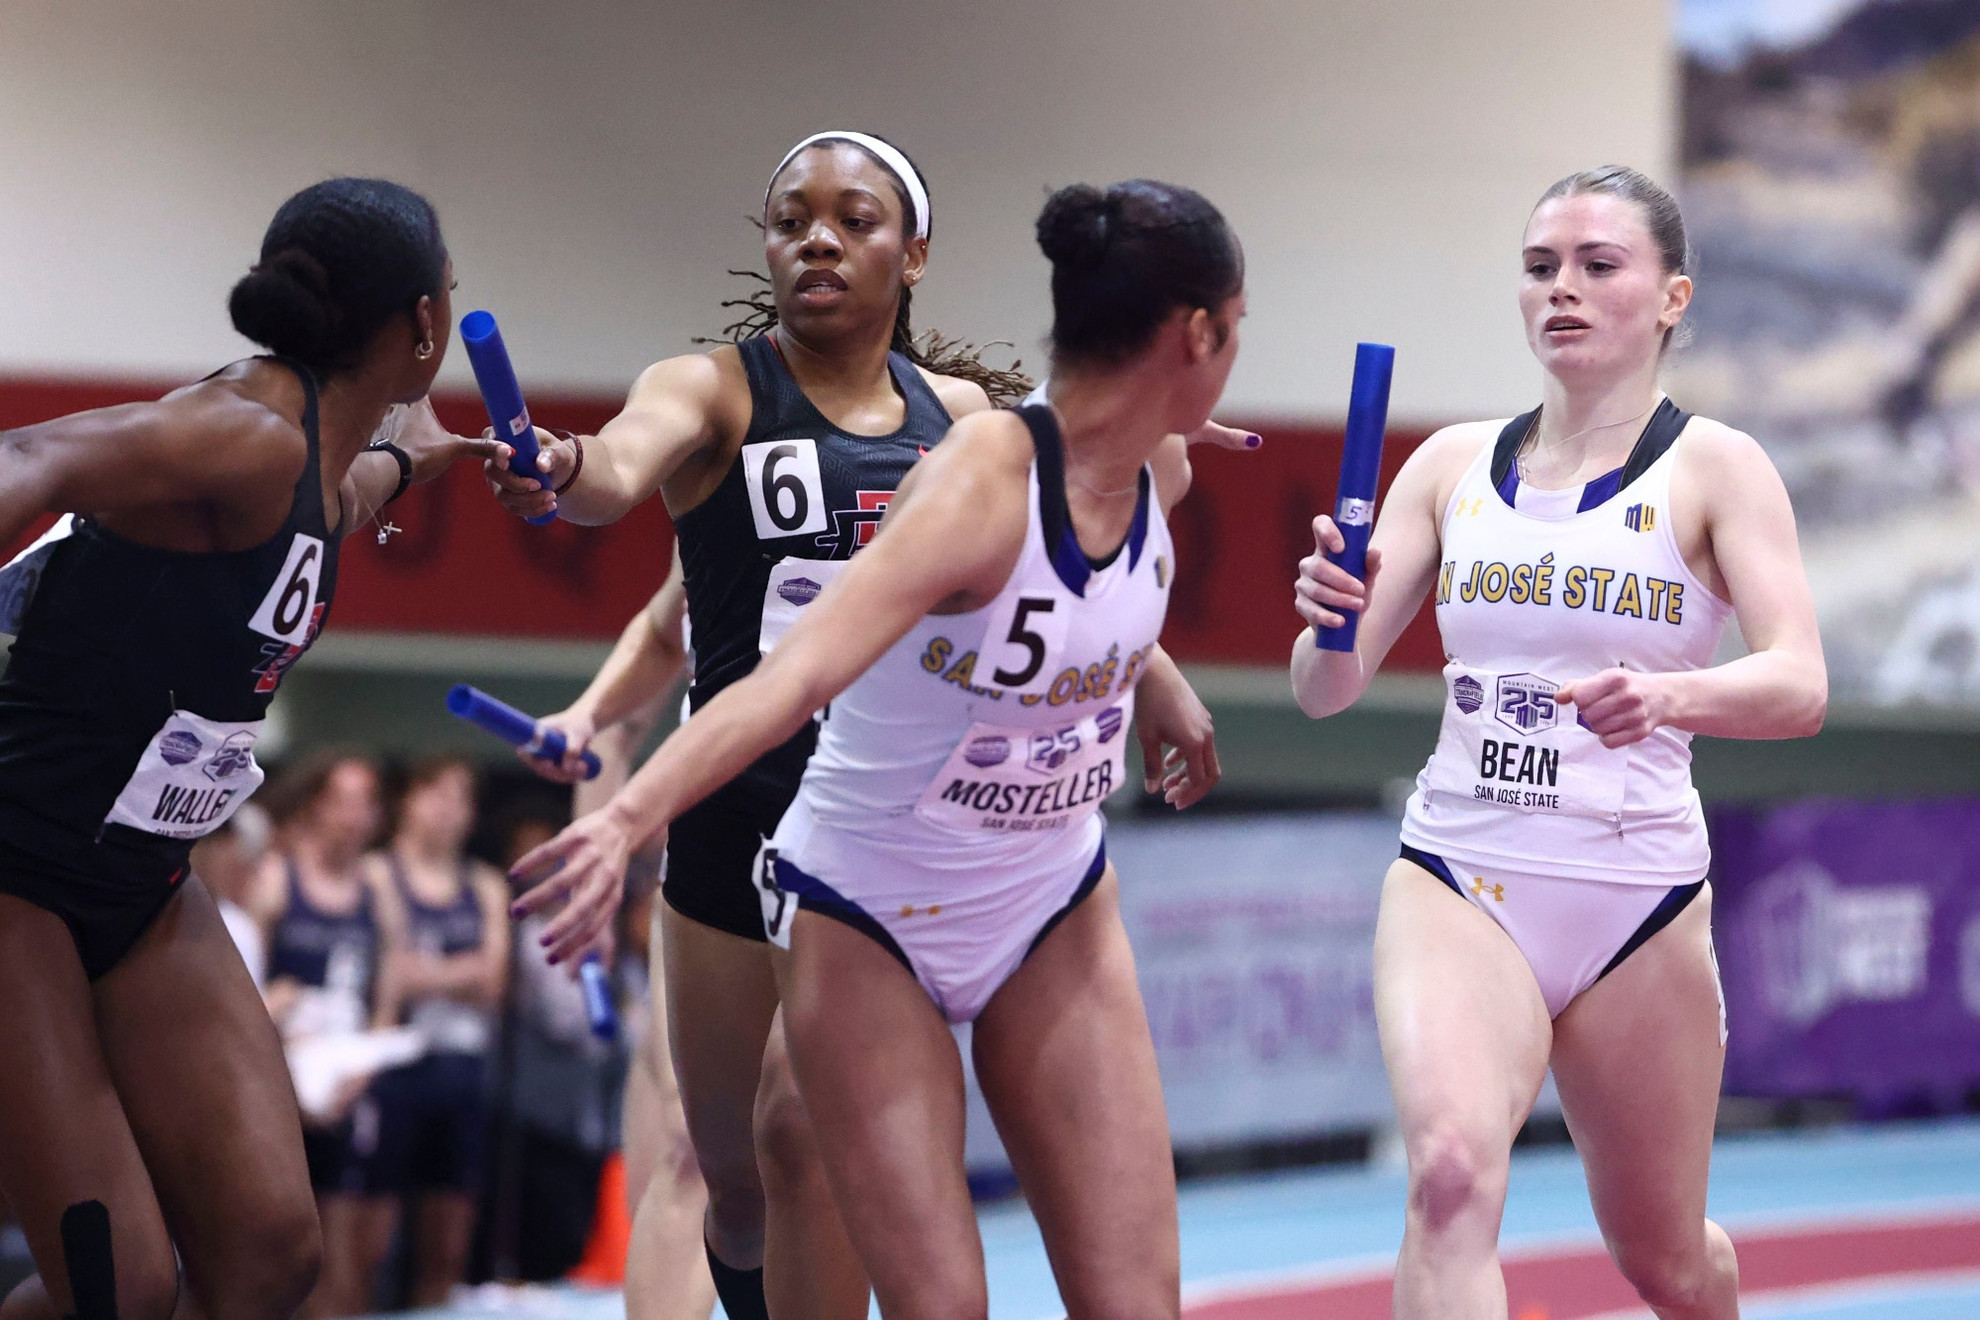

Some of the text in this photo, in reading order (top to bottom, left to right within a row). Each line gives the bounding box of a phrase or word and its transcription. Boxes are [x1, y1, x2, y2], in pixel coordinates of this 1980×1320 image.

[762, 444, 808, 531] 6
[1345, 506, 1362, 520] 5
[272, 543, 317, 635] 6
[1436, 552, 1684, 625] N JOSÉ STATE
[993, 597, 1055, 687] 5
[920, 636, 1003, 700] SA
[1019, 642, 1119, 707] OSÉ
[1502, 680, 1534, 688] MOUNTAIN
[1501, 687, 1554, 719] 25
[1034, 726, 1081, 761] 25
[1481, 739, 1559, 787] BEAN
[942, 759, 1112, 815] MOSTELLER
[1474, 785, 1559, 809] SAN JOSÉ STATE
